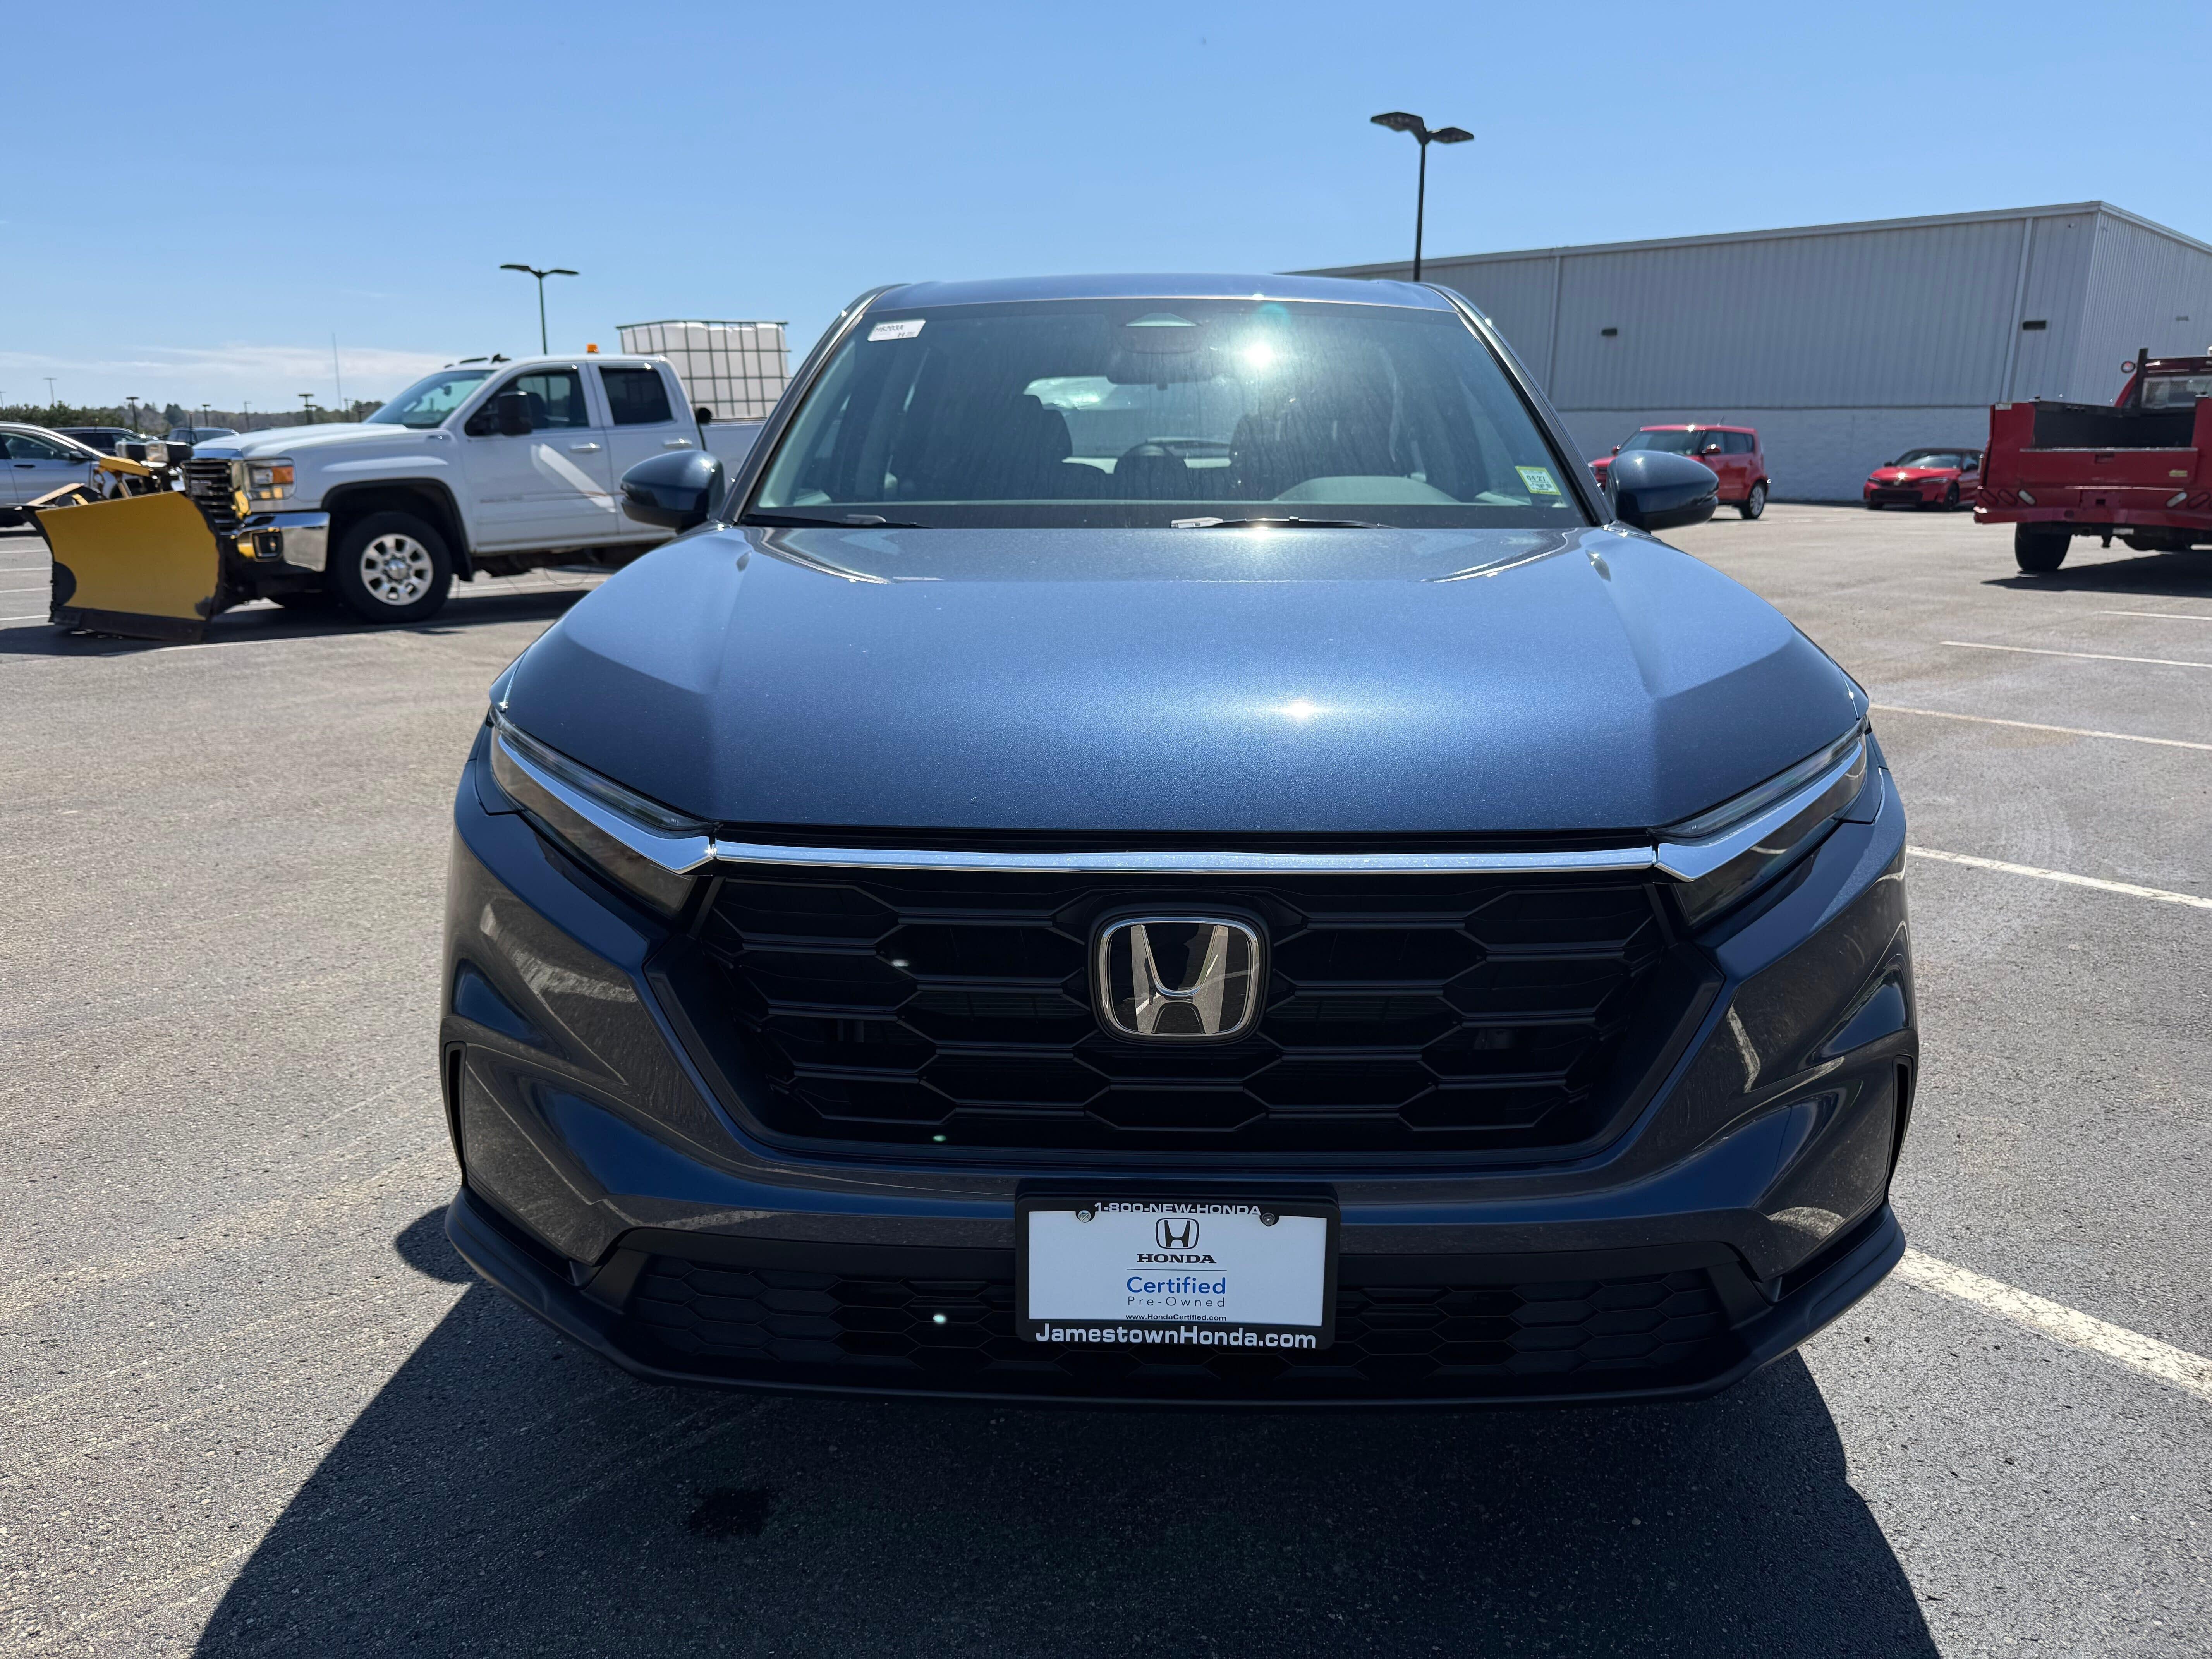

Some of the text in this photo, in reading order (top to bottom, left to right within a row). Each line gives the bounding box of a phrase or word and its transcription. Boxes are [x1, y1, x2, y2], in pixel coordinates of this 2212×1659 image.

[1094, 1202, 1261, 1215] 1-800-NEW-HONDA
[1137, 1253, 1217, 1264] HONDA
[1127, 1276, 1226, 1294] Certified
[1128, 1296, 1225, 1307] Pre-Owned
[1035, 1323, 1316, 1348] JamestownHonda.com
